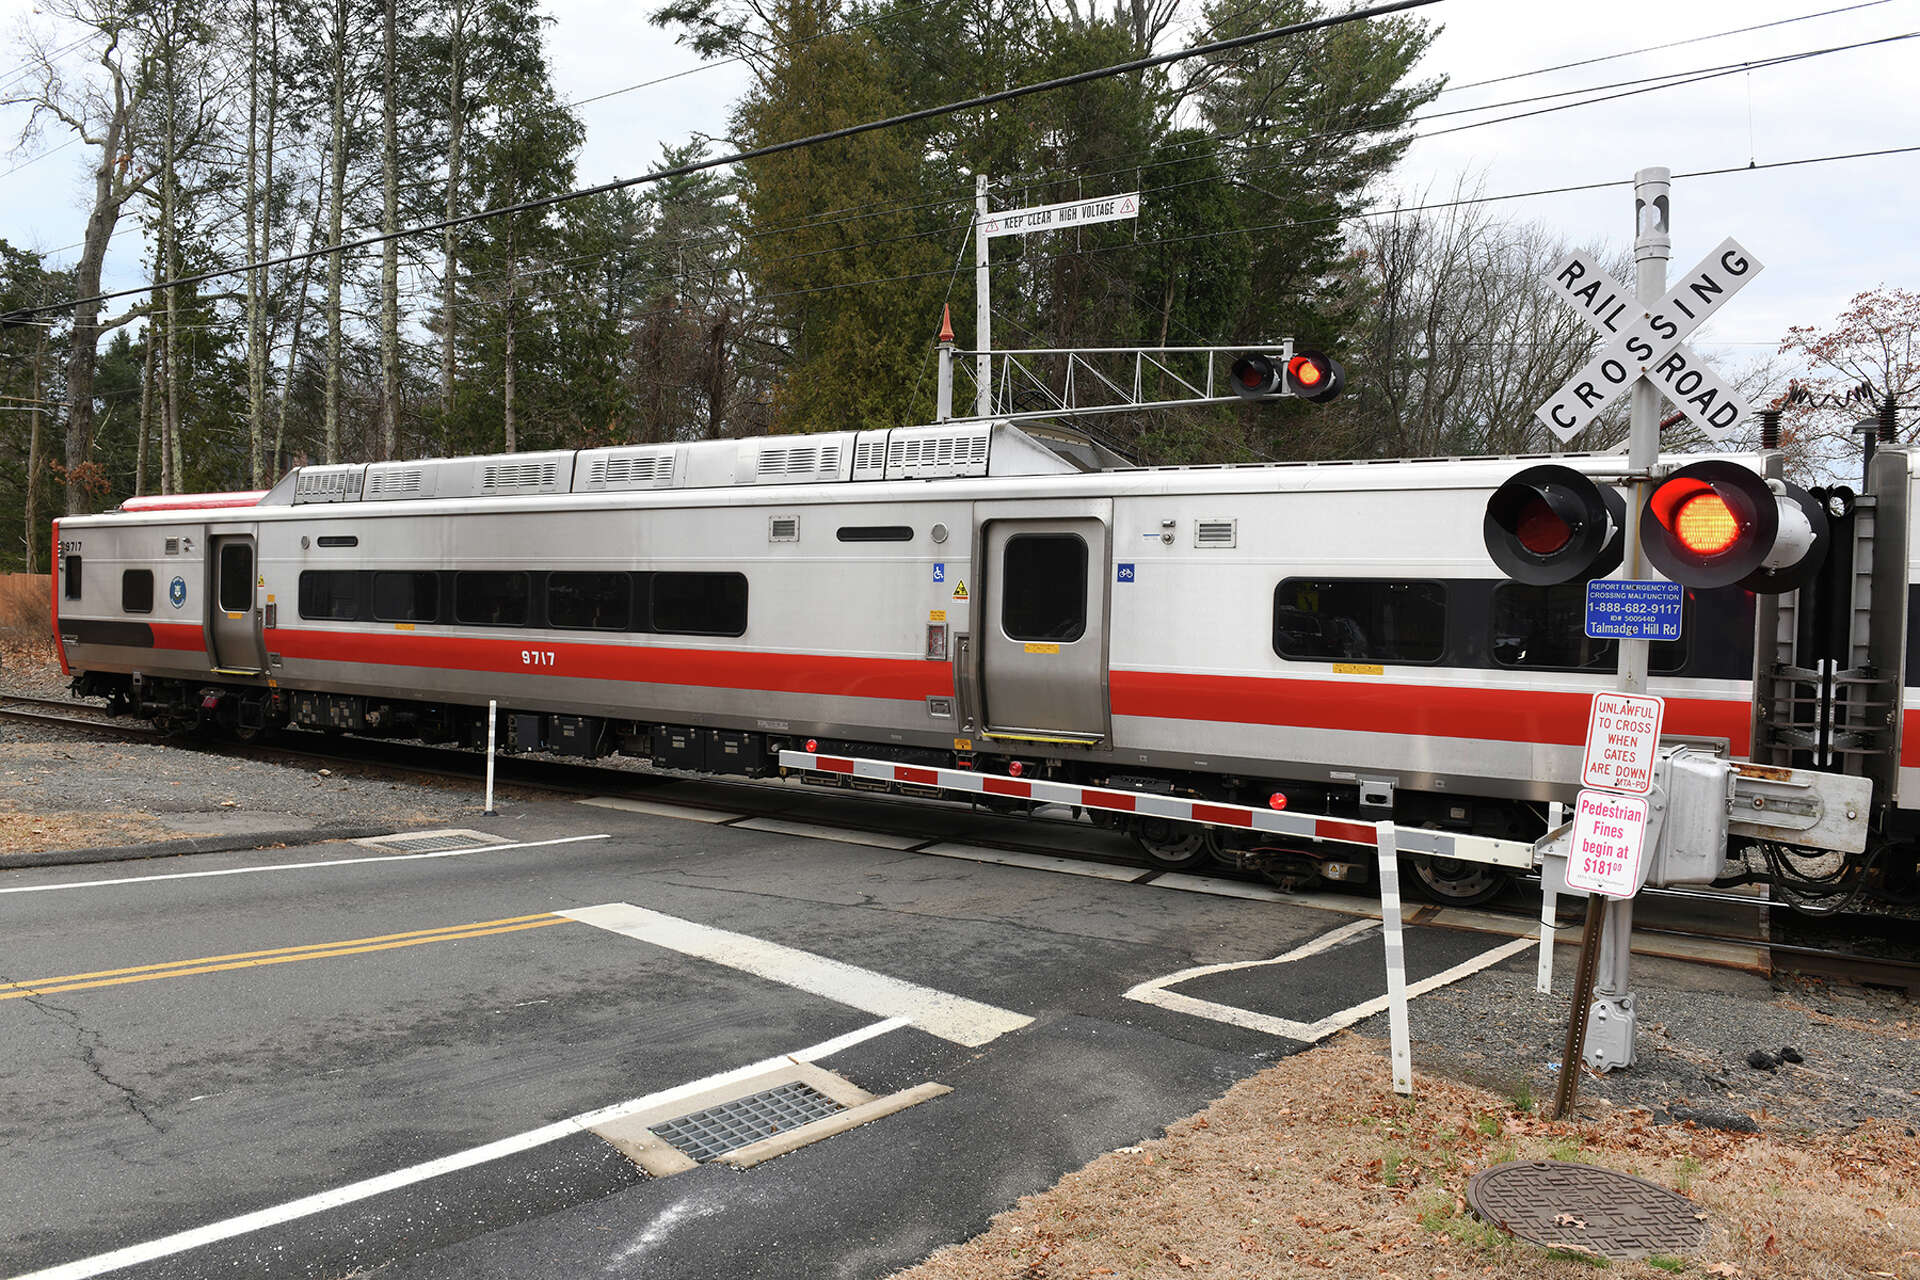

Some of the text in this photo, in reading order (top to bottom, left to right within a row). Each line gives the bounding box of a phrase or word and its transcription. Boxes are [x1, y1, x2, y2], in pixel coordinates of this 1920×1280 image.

[1004, 202, 1115, 229] KEEP CLEAR HIGH VOLTAGE
[1551, 250, 1749, 429] CROSSING
[1557, 259, 1739, 429] RAIL ROAD
[65, 541, 82, 551] 9717
[1591, 583, 1619, 591] REPORT
[1628, 592, 1680, 600] MALFUNCTION
[1588, 602, 1681, 614] 1-888-682-9117
[1590, 622, 1677, 636] Talmadge Hill Rd
[521, 650, 555, 666] 9717
[1599, 702, 1654, 719] UNLAWFUL
[1599, 717, 1652, 734] TO CROSS
[1608, 733, 1638, 747] WHEN
[1604, 748, 1636, 763] GATES
[1590, 762, 1647, 780] ARE DOWN
[1581, 799, 1642, 822] Pedestrian
[1593, 820, 1624, 839] Fines
[1582, 838, 1629, 860] begin at
